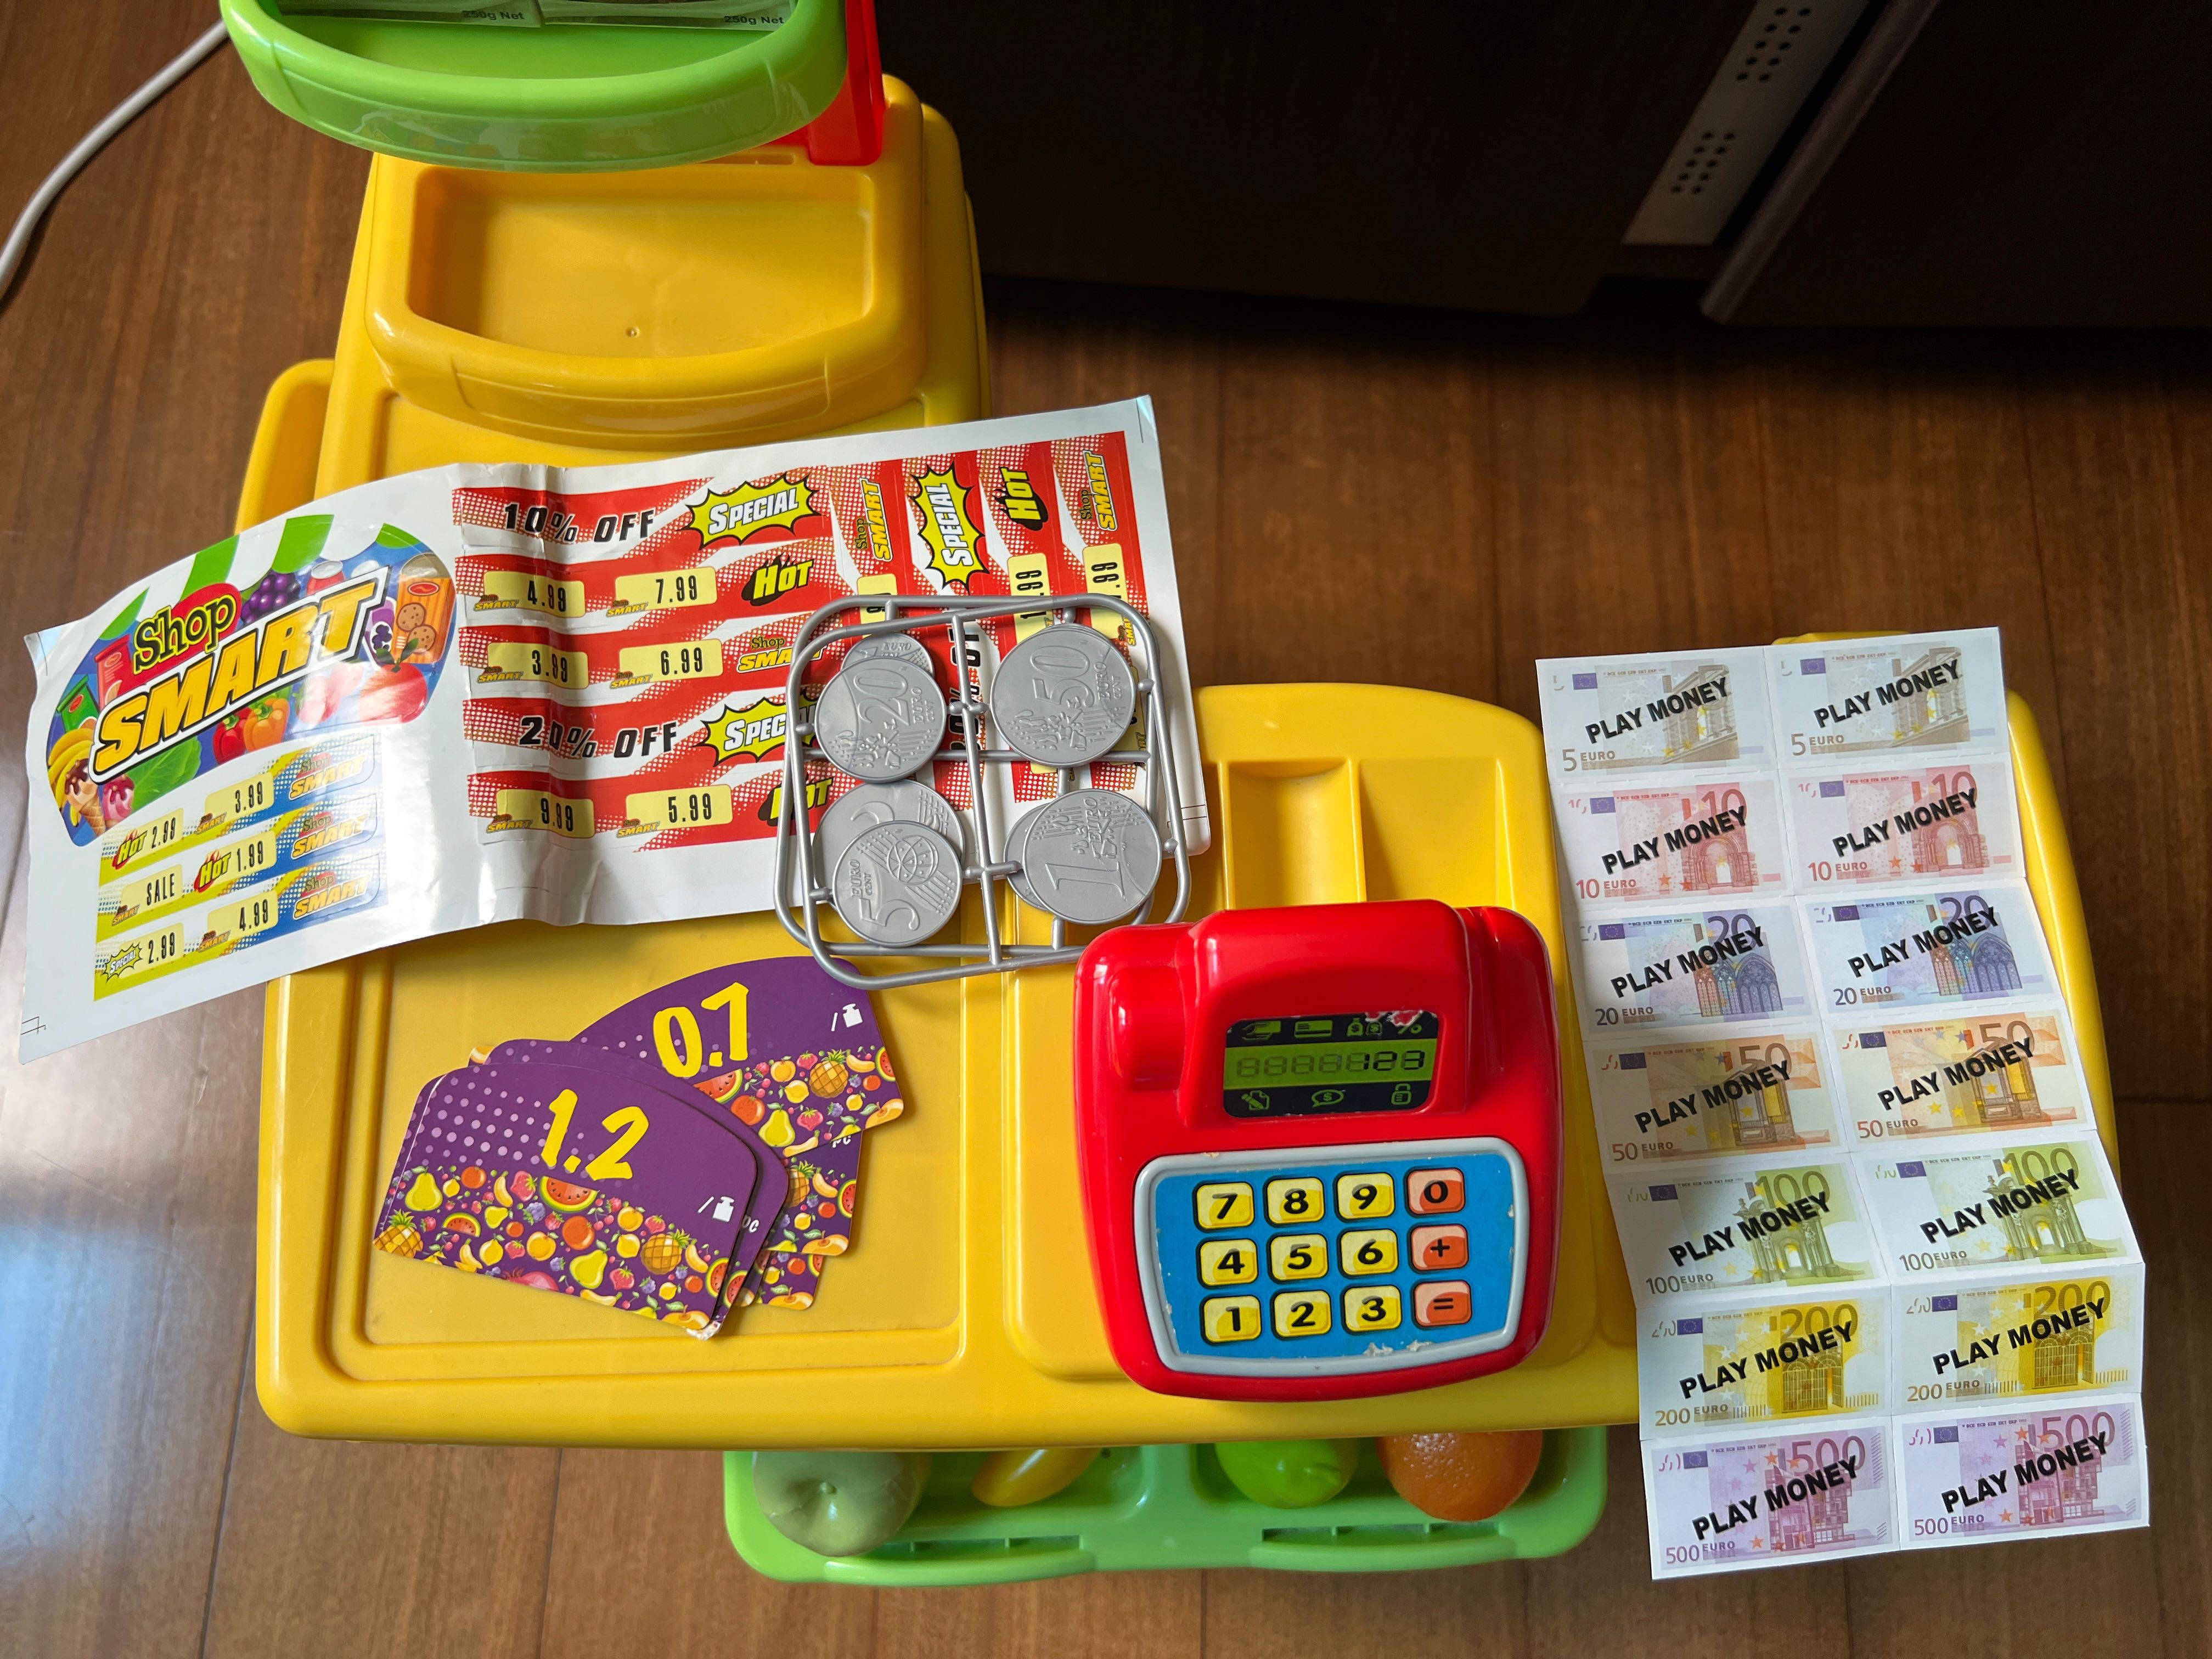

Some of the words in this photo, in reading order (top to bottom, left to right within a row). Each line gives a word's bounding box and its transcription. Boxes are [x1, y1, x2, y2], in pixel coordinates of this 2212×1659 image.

[499, 11, 525, 20] Net
[724, 15, 757, 25] 250g
[761, 16, 785, 24] Net
[1000, 467, 1042, 520] HOT
[1080, 489, 1094, 521] Shop
[1083, 450, 1117, 531] SMART
[505, 503, 578, 543] 10%
[593, 507, 656, 543] OFF
[854, 518, 868, 549] Shop
[860, 478, 893, 562] SMART
[527, 580, 566, 612] 4.99
[656, 575, 697, 604] 7.99
[753, 558, 815, 600] HOT
[474, 599, 520, 612] SMART
[606, 602, 648, 617] SMART
[133, 594, 237, 675] Shop
[751, 636, 785, 650] Shop
[92, 579, 379, 774] SMART
[477, 671, 524, 684] SMART
[531, 650, 568, 683] 3.99
[661, 647, 703, 676] 6.99
[1029, 645, 1095, 708] 50
[610, 674, 653, 689] SMART
[853, 668, 911, 726] 20
[1814, 691, 1870, 728] PLAY
[1876, 659, 1961, 706] MONEY
[1585, 707, 1642, 743] PLAY
[1646, 677, 1729, 723] MONEY
[519, 715, 598, 758] 20%
[613, 721, 677, 758] OFF
[1791, 733, 1806, 756] 5
[1809, 734, 1844, 745] EURO
[300, 757, 330, 774] Shop
[1562, 749, 1577, 771] 5
[1580, 750, 1616, 761] EURO
[290, 755, 367, 800] SMART
[1932, 771, 1977, 803] 10
[235, 781, 263, 814] 3.99
[540, 797, 574, 832] 9.99
[668, 793, 712, 823] 5.99
[1701, 789, 1747, 822] 10
[196, 812, 227, 835] SMART
[291, 814, 369, 860] SMART
[302, 815, 333, 832] Shop
[486, 819, 533, 834] SMART
[616, 821, 661, 838] SMART
[1601, 837, 1658, 874] PLAY
[1664, 805, 1747, 851] MONEY
[1833, 820, 1888, 857] PLAY
[1894, 788, 1977, 834] MONEY
[117, 830, 148, 865] HOT
[151, 817, 176, 849] 2.99
[199, 851, 232, 887] HOT
[237, 840, 264, 872] 1.99
[849, 859, 862, 898] EURO
[1808, 861, 1832, 882] 10
[1836, 861, 1867, 872] EURO
[146, 873, 176, 906] SALE
[294, 875, 372, 920] SMART
[305, 874, 335, 893] Shop
[1575, 879, 1600, 899] 10
[1604, 879, 1636, 889] EURO
[111, 905, 140, 927] SMART
[239, 899, 269, 930] 4.99
[859, 897, 921, 932] 5
[1940, 895, 1989, 929] 20
[199, 930, 232, 952] SMART
[1708, 913, 1756, 947] 20
[1847, 939, 1907, 978] PLAY
[1912, 906, 1999, 953] MONEY
[148, 932, 176, 964] 2.99
[1610, 959, 1671, 998] PLAY
[1676, 926, 1766, 974] MONEY
[1833, 987, 1858, 1006] 20
[1860, 985, 1892, 996] EURO
[1595, 1007, 1619, 1026] 20
[1622, 1006, 1653, 1016] EURO
[1979, 1020, 2034, 1056] 50
[1739, 1042, 1792, 1078] 50
[1877, 1071, 1940, 1111] PLAY
[1944, 1037, 2034, 1086] MONEY
[1634, 1094, 1696, 1133] PLAY
[1701, 1060, 1791, 1109] MONEY
[540, 1088, 650, 1181] 1.2
[1857, 1121, 1883, 1139] 50
[1886, 1119, 1918, 1128] EURO
[1612, 1143, 1637, 1161] 50
[1641, 1141, 1673, 1151] EURO
[2003, 1148, 2079, 1184] 100
[1213, 1193, 1237, 1219] 7
[1284, 1188, 1309, 1215] 8
[1352, 1183, 1378, 1210] 9
[1424, 1180, 1448, 1203] 0
[1756, 1170, 1830, 1207] 100
[1920, 1203, 1988, 1244] PLAY
[1987, 1169, 2080, 1218] MONEY
[1669, 1226, 1735, 1267] PLAY
[1738, 1192, 1832, 1242] MONEY
[1218, 1249, 1245, 1273] 4
[1287, 1244, 1312, 1269] 5
[1358, 1239, 1383, 1265] 6
[1430, 1239, 1450, 1257] +
[1899, 1252, 1934, 1271] 100
[1934, 1251, 1967, 1261] EURO
[1646, 1276, 1680, 1295] 100
[1680, 1273, 1713, 1283] EURO
[2034, 1280, 2110, 1318] 200
[1225, 1306, 1241, 1331] 1
[1291, 1301, 1316, 1327] 2
[1361, 1296, 1386, 1322] 3
[1433, 1297, 1454, 1310] =
[1780, 1304, 1858, 1343] 200
[1932, 1334, 2001, 1375] PLAY
[2007, 1297, 2105, 1349] MONEY
[1679, 1357, 1747, 1399] PLAY
[1754, 1321, 1853, 1373] MONEY
[1907, 1384, 1943, 1401] 200
[1945, 1379, 1980, 1390] EURO
[1655, 1408, 1690, 1426] 200
[1694, 1404, 1728, 1414] EURO
[2042, 1412, 2115, 1450] 500
[1792, 1436, 1866, 1475] 500
[1941, 1469, 2007, 1514] PLAY
[2014, 1431, 2107, 1486] MONEY
[1692, 1494, 1758, 1541] PLAY
[1764, 1455, 1857, 1511] MONEY
[1914, 1517, 1949, 1536] 500
[1951, 1514, 1984, 1525] EURO
[1666, 1545, 1699, 1564] 500
[1702, 1541, 1735, 1551] EURO
